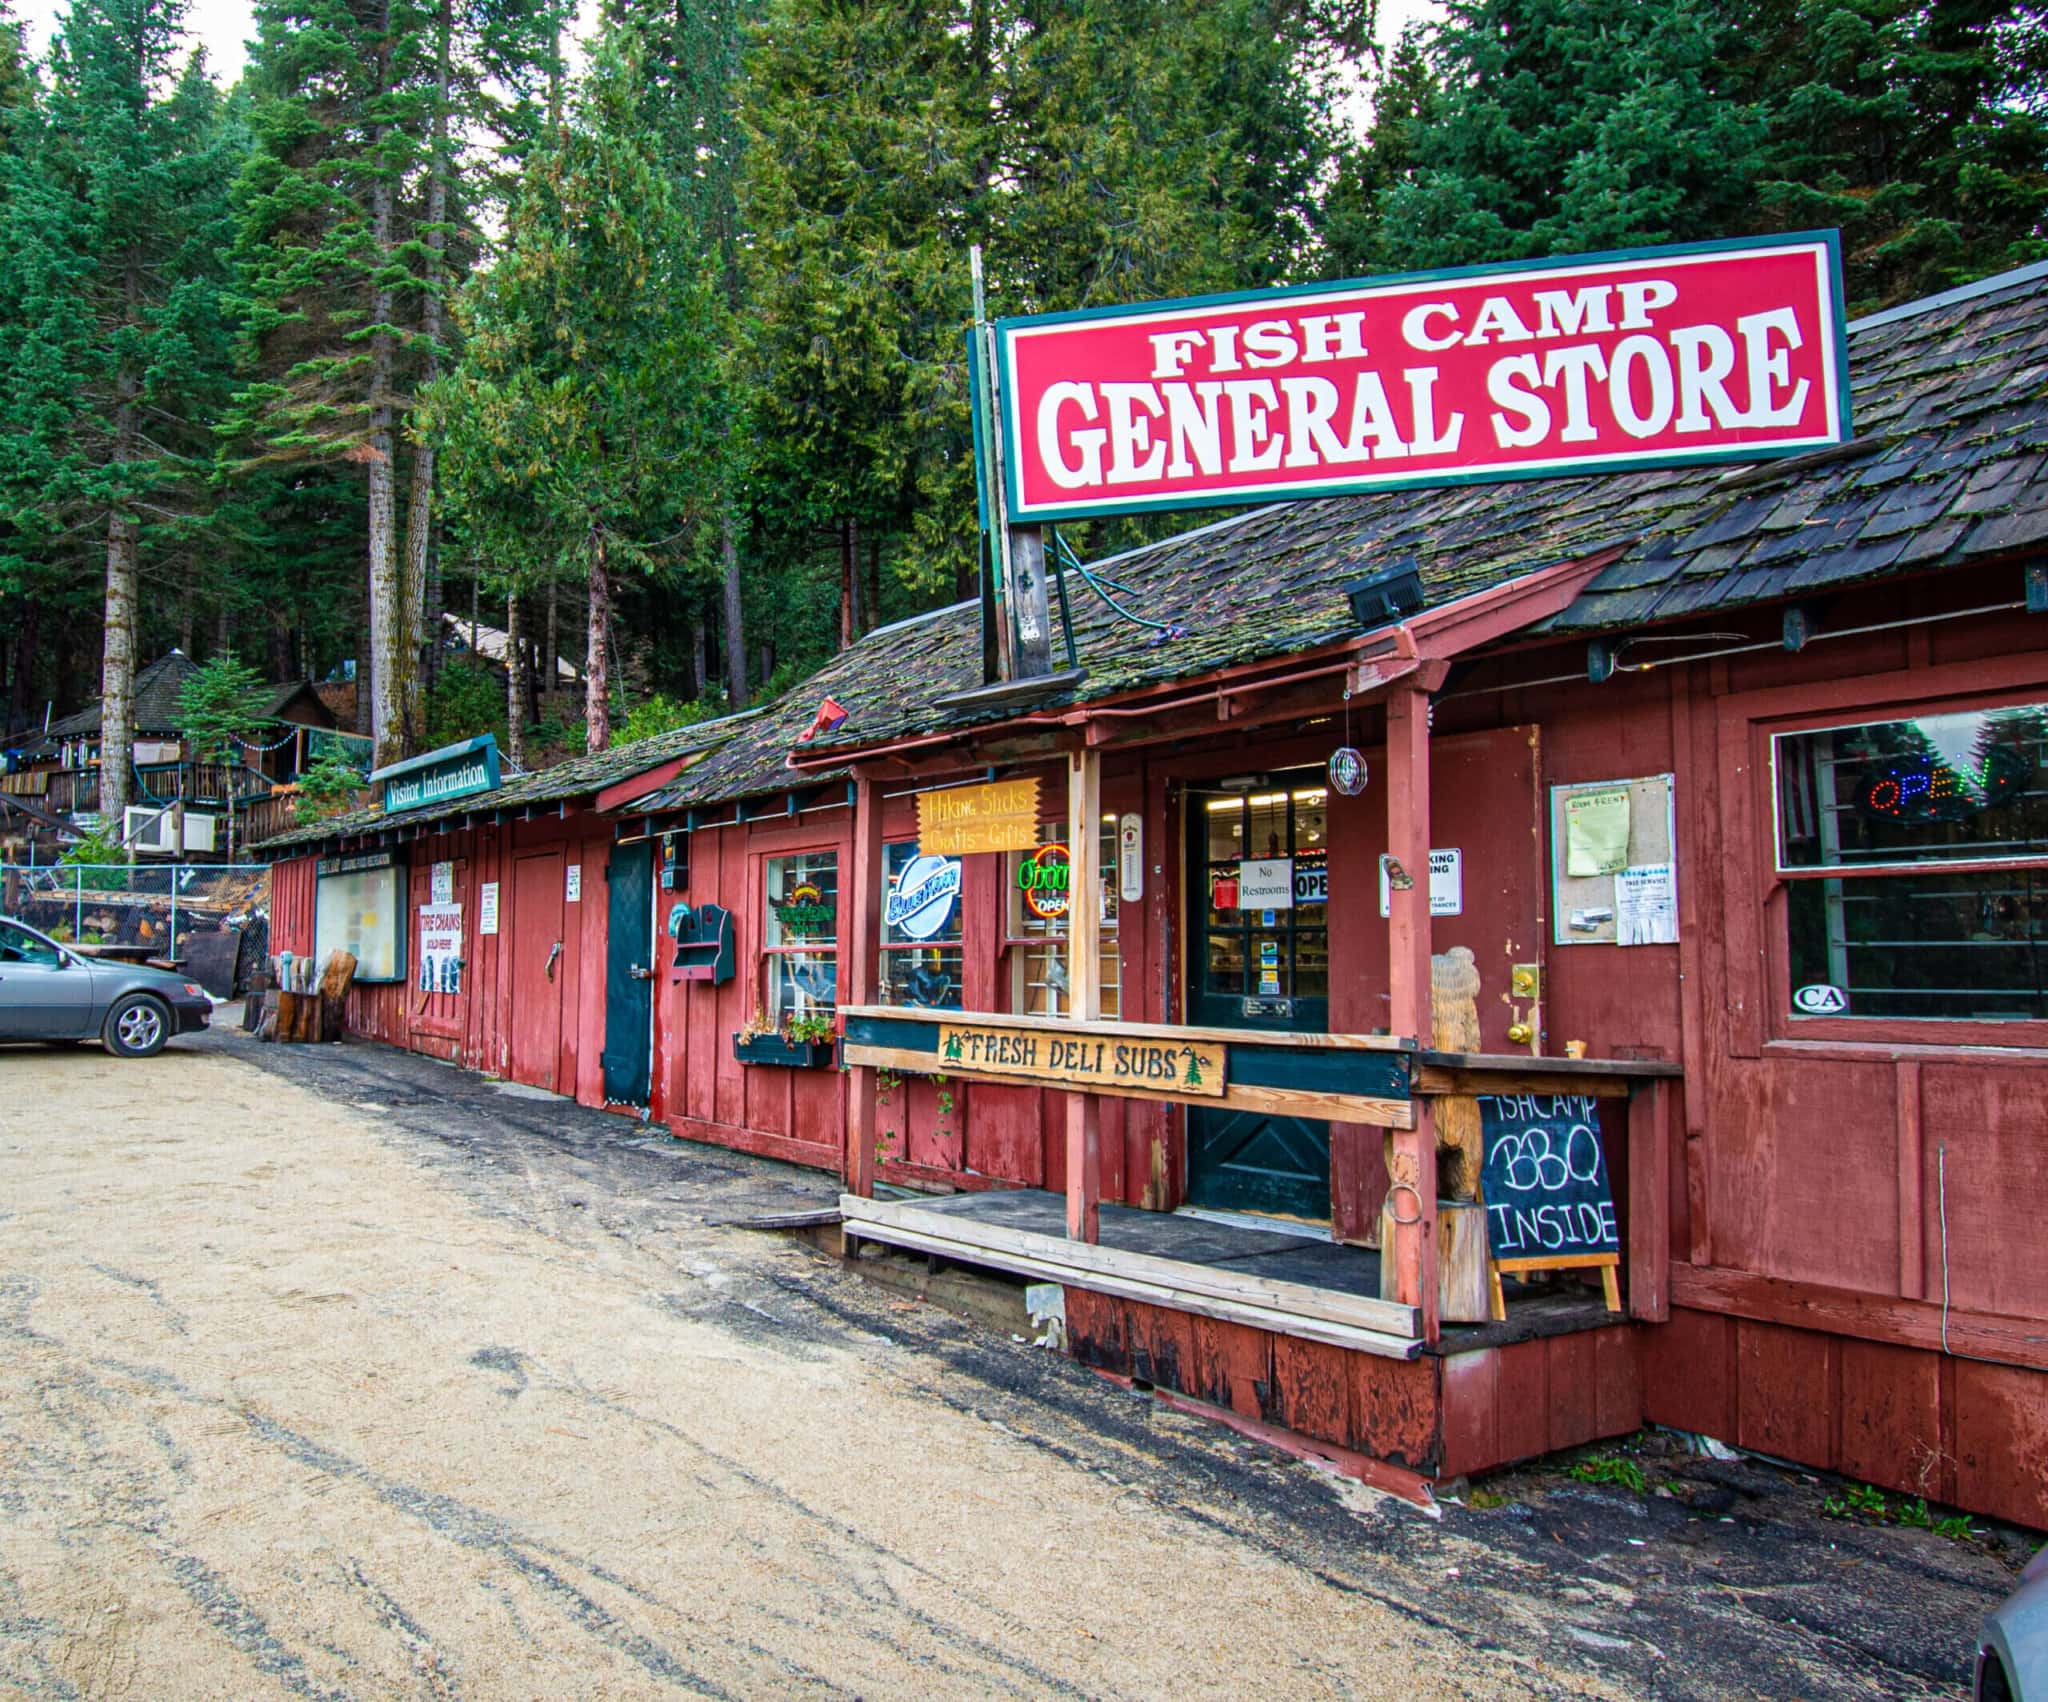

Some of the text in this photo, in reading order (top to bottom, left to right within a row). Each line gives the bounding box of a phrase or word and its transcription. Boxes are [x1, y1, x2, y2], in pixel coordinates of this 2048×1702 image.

[1150, 279, 1678, 379] FISH CAMP
[1037, 306, 1811, 489] GENERAL STORE
[390, 761, 486, 806] Visitor Information
[1869, 756, 1991, 810] OPEN
[1242, 885, 1290, 897] Restrooms
[1259, 867, 1273, 878] No
[1296, 874, 1328, 897] OPE
[434, 913, 460, 932] CHAINS
[1798, 988, 1845, 1008] CA
[970, 1032, 1178, 1081] FRESH DELI SUBS
[1490, 1124, 1600, 1190] BBQ
[1487, 1201, 1619, 1249] INSIDE
